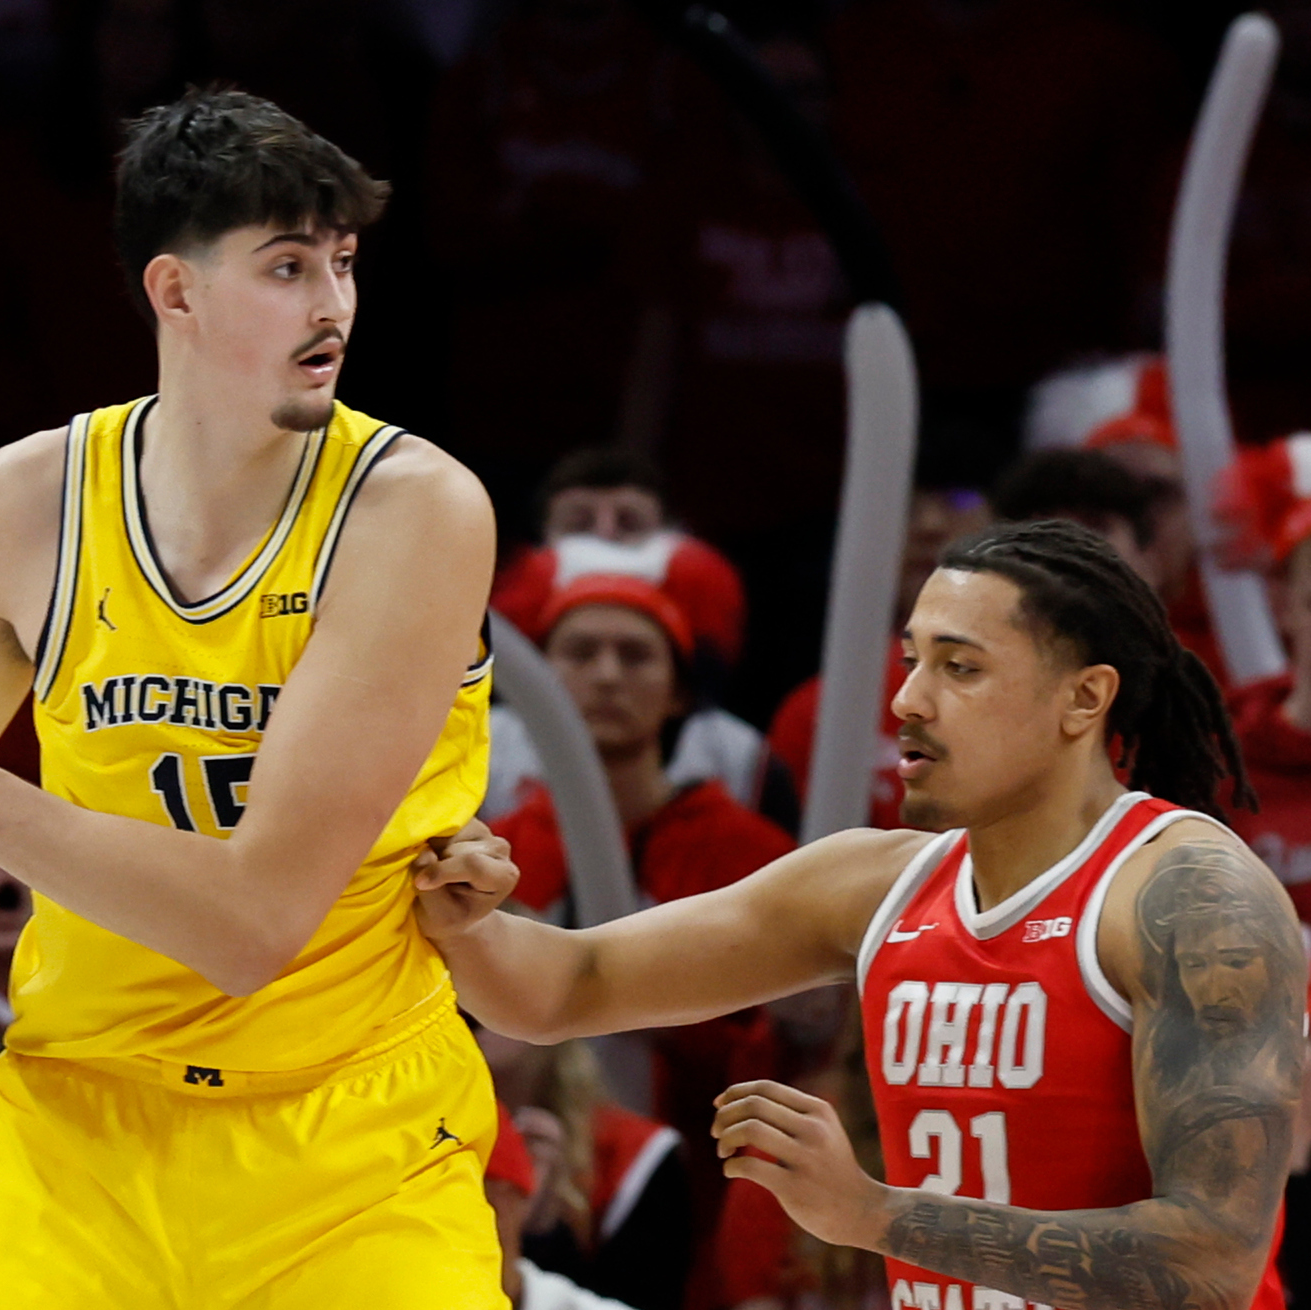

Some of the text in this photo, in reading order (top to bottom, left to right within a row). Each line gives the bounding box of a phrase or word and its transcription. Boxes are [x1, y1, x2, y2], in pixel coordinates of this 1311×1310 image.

[183, 1065, 223, 1087] M
[880, 980, 1048, 1089] OHIO
[908, 1109, 1011, 1205] 21
